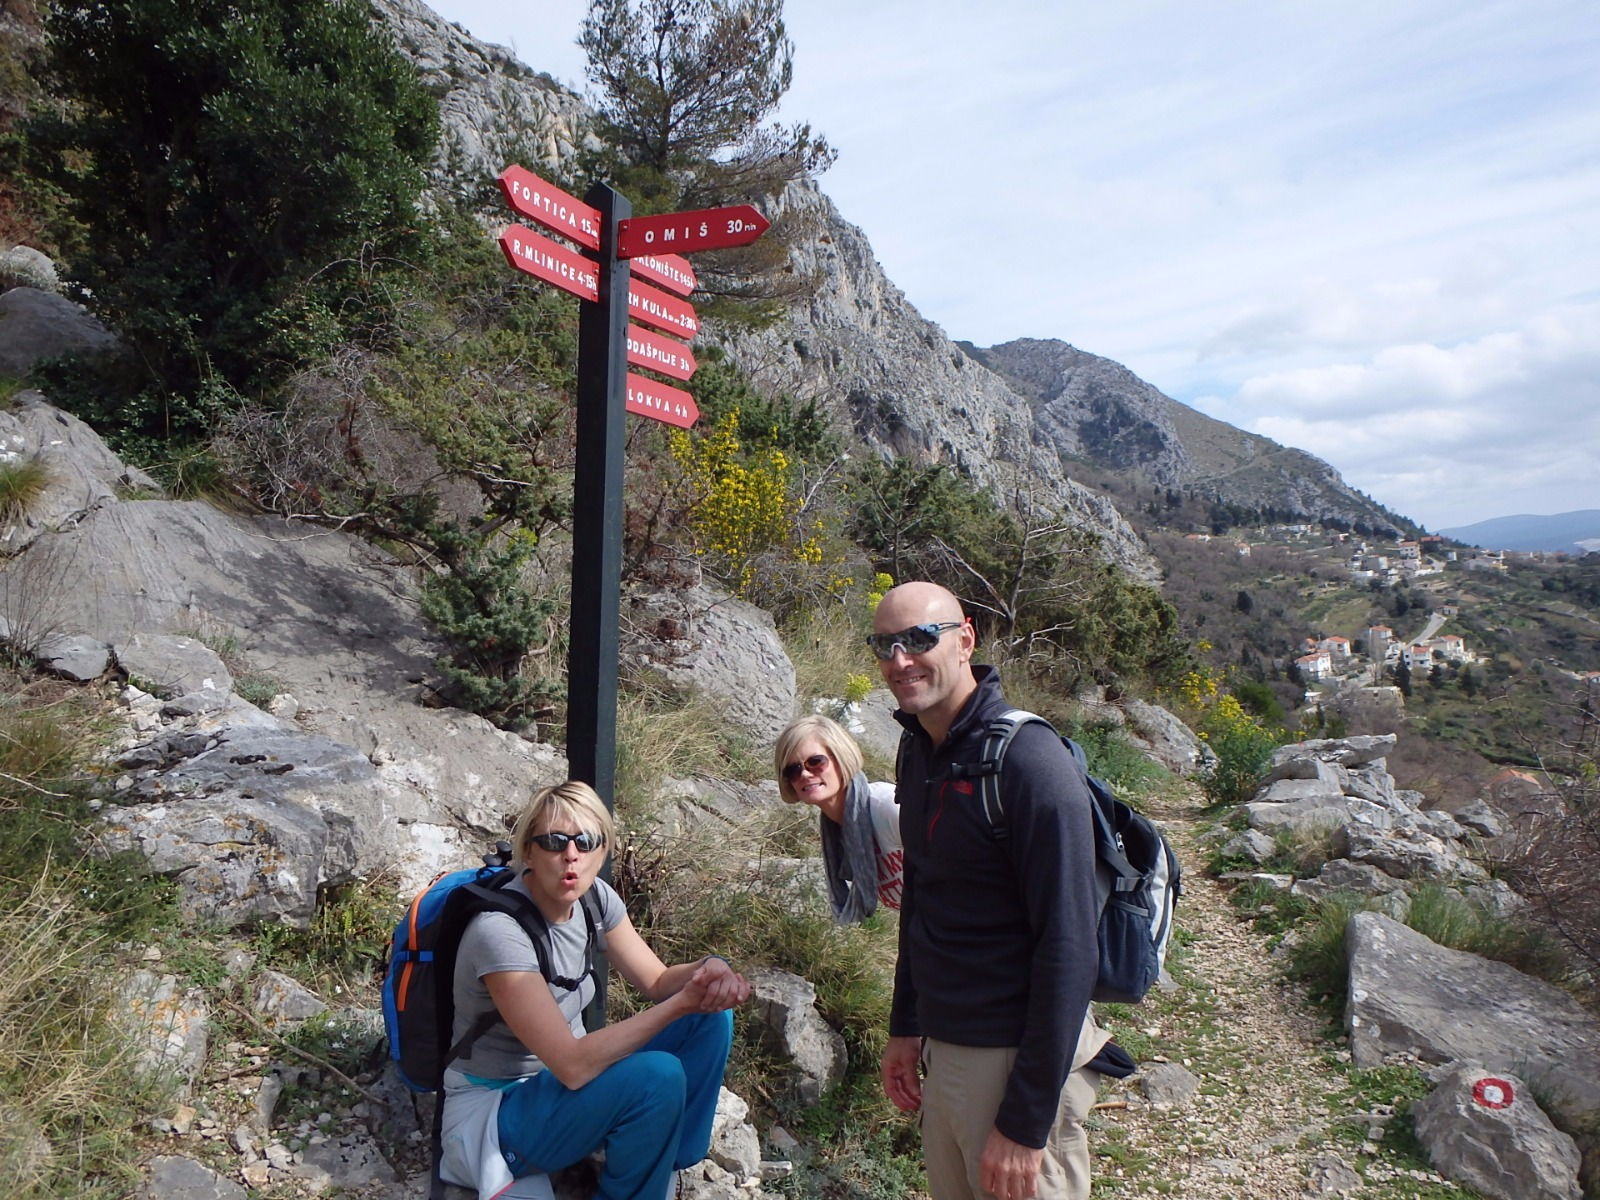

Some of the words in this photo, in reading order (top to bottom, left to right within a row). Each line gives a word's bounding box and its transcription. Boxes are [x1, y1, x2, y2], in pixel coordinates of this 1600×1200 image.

[513, 181, 577, 227] FORTICA
[644, 222, 708, 243] OMIŠ
[513, 239, 576, 281] R.MLINICE
[642, 298, 668, 320] KULA
[627, 338, 677, 366] ODAŠPILJE
[628, 388, 670, 413] LOKVA
